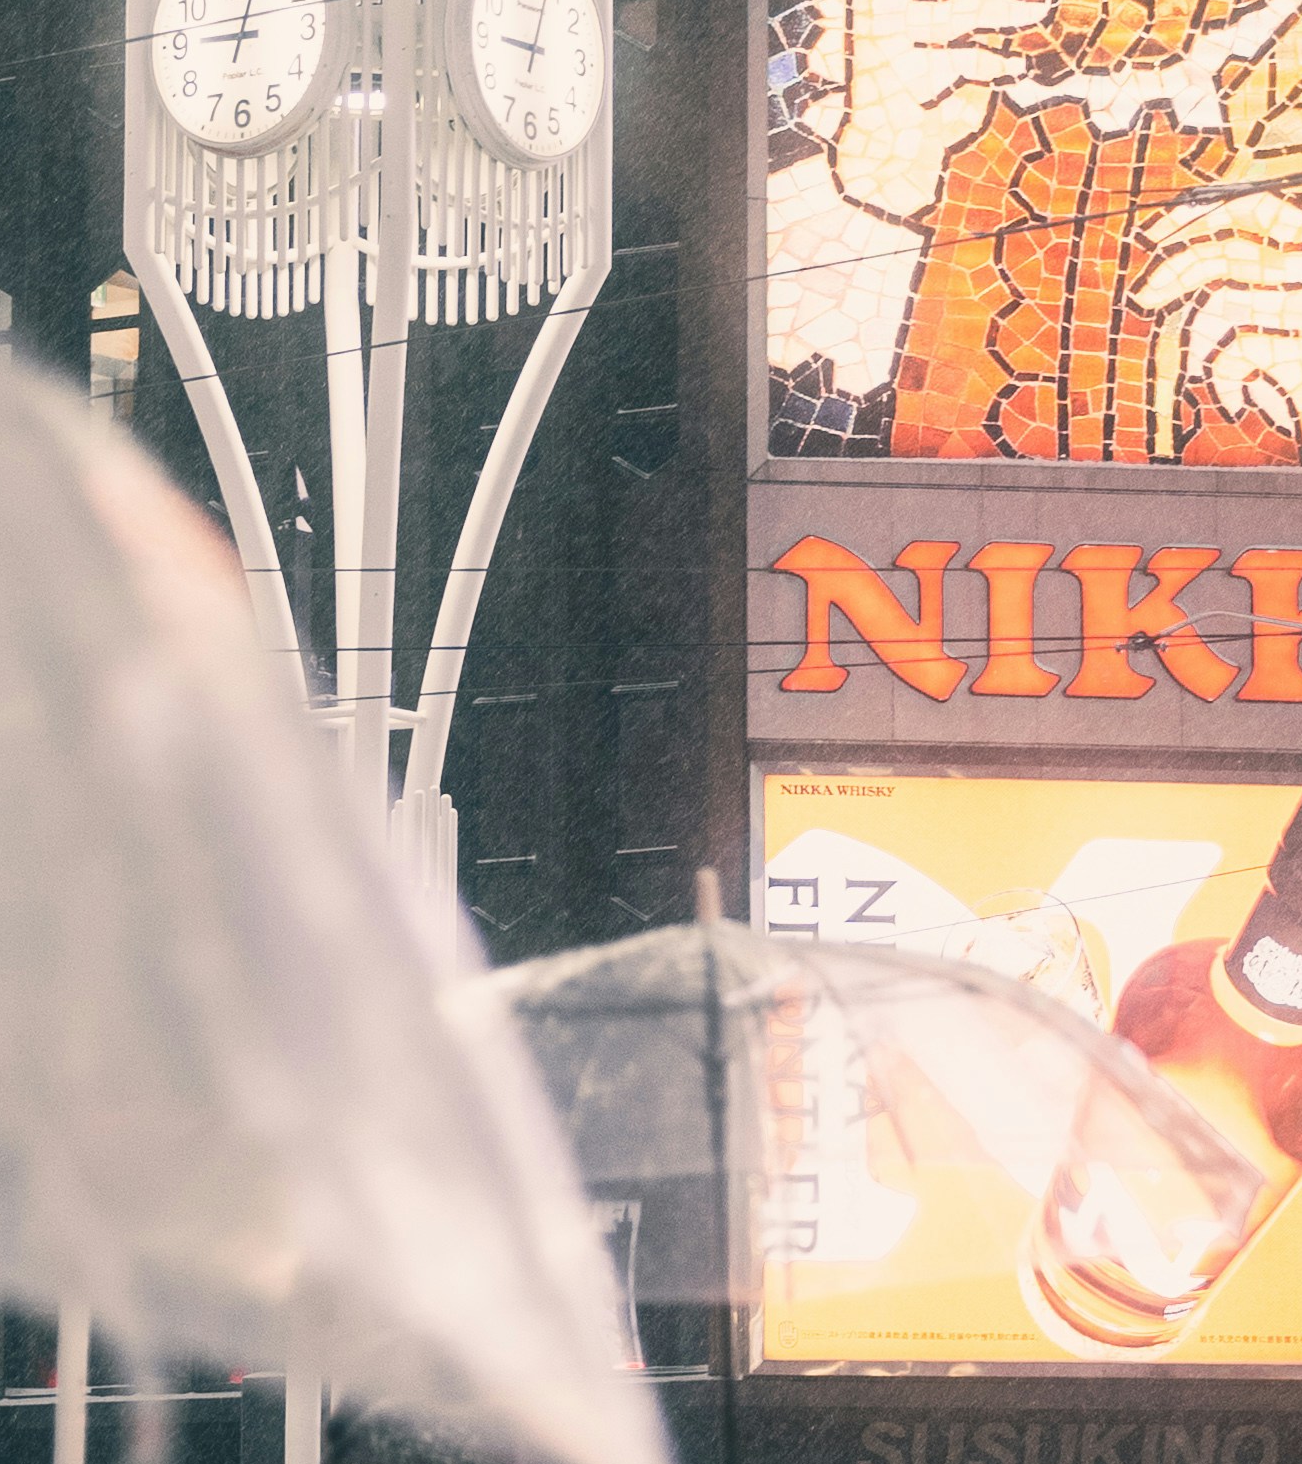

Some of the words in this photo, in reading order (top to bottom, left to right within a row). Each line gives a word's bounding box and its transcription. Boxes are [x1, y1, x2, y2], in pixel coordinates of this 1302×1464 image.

[300, 13, 316, 41] 3
[476, 21, 489, 49] 9
[567, 8, 580, 36] 2
[172, 31, 188, 61] 9
[288, 53, 303, 81] 4
[484, 62, 496, 90] 8
[574, 48, 587, 77] 3
[182, 70, 198, 98] 8
[265, 83, 282, 113] 5
[207, 93, 224, 122] 7
[503, 95, 516, 123] 7
[565, 86, 577, 113] 4
[234, 99, 251, 129] 6
[524, 111, 537, 141] 6
[548, 107, 560, 136] 5
[780, 783, 833, 797] NIKKA
[835, 784, 897, 798] WHISKY
